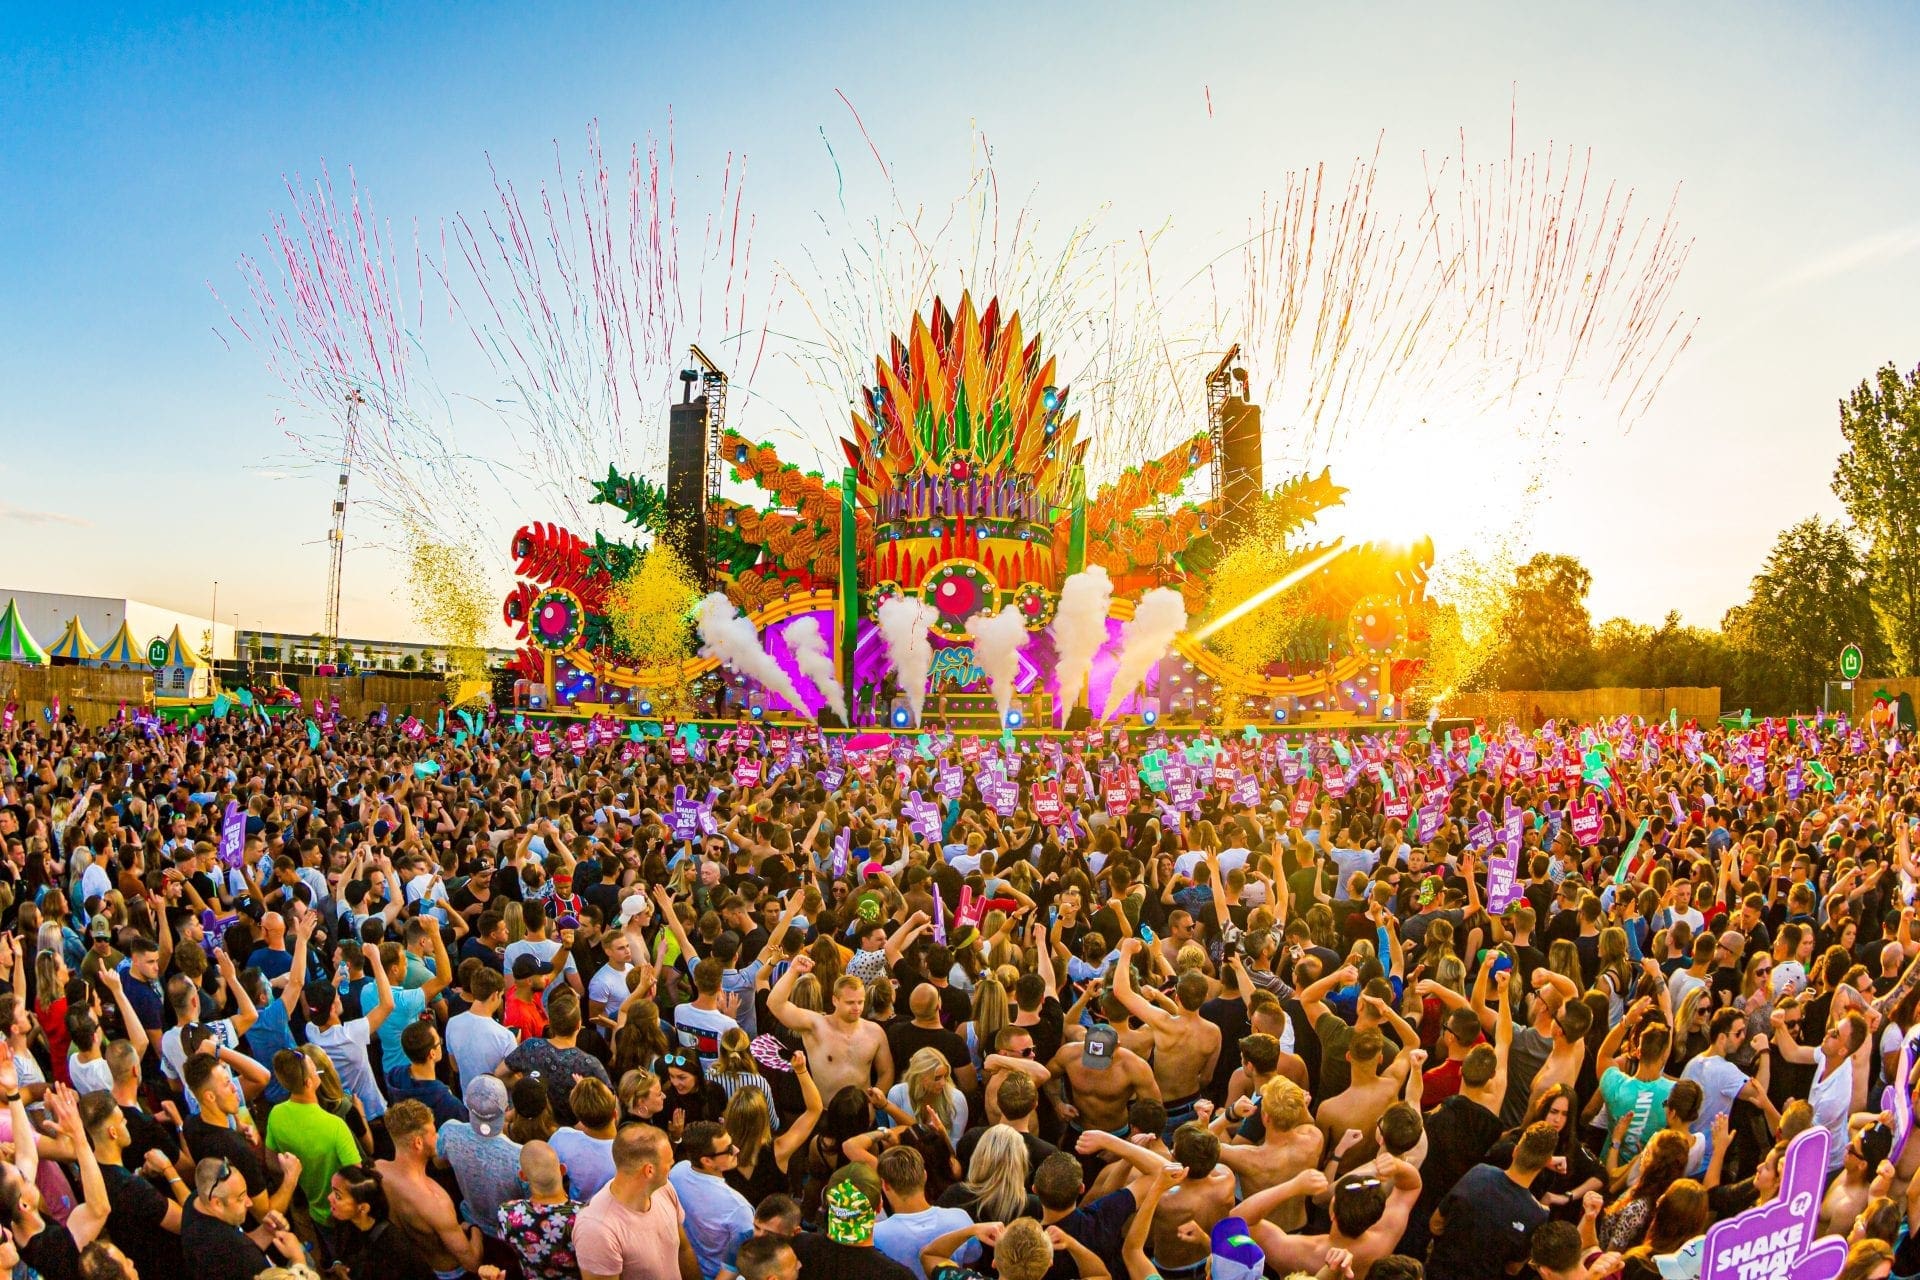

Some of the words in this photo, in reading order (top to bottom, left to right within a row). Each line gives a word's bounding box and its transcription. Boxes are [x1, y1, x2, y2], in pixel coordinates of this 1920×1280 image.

[1493, 867, 1513, 878] SHAKE
[1492, 883, 1510, 896] ASS
[1716, 1222, 1804, 1272] SHAKE
[1737, 1244, 1800, 1280] THAT
